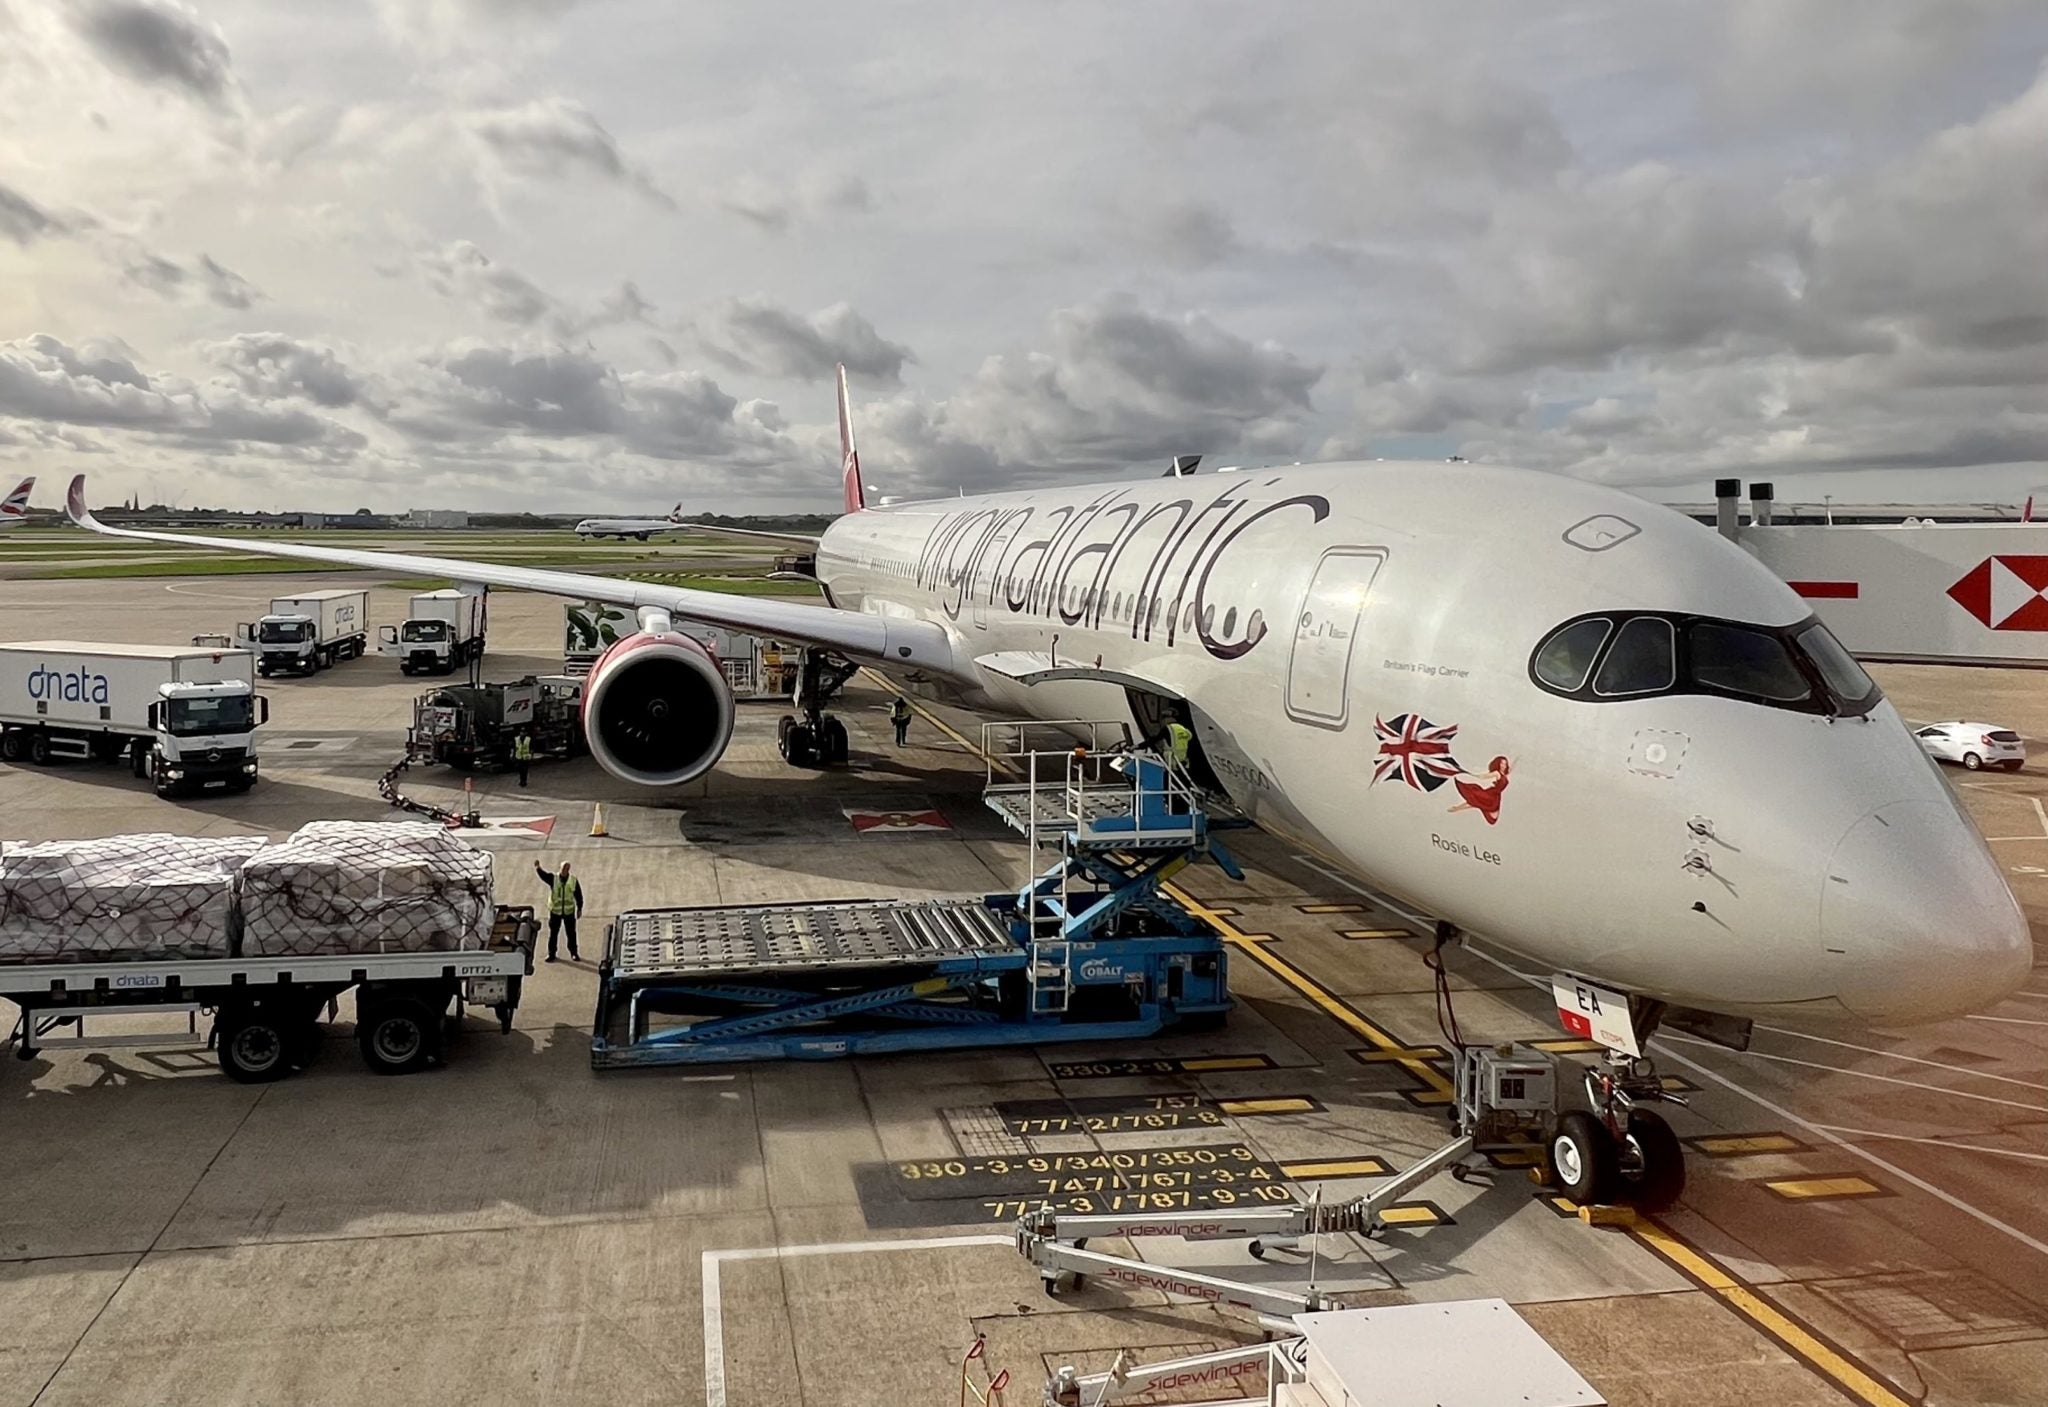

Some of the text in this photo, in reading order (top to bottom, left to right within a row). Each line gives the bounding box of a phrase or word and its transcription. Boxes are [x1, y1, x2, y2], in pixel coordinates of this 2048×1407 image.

[917, 477, 1330, 660] virgin atlantic
[28, 663, 109, 704] dnata
[1418, 663, 1436, 676] Flag
[1438, 666, 1470, 678] Carrier
[1431, 833, 1502, 866] Rosie Lee
[116, 974, 160, 986] dnata
[462, 966, 492, 974] DTT22
[1575, 986, 1603, 1017] EA
[1106, 1222, 1222, 1237] sidewinder
[1097, 1267, 1224, 1301] sidewinder
[1139, 1359, 1264, 1394] sidewinder
